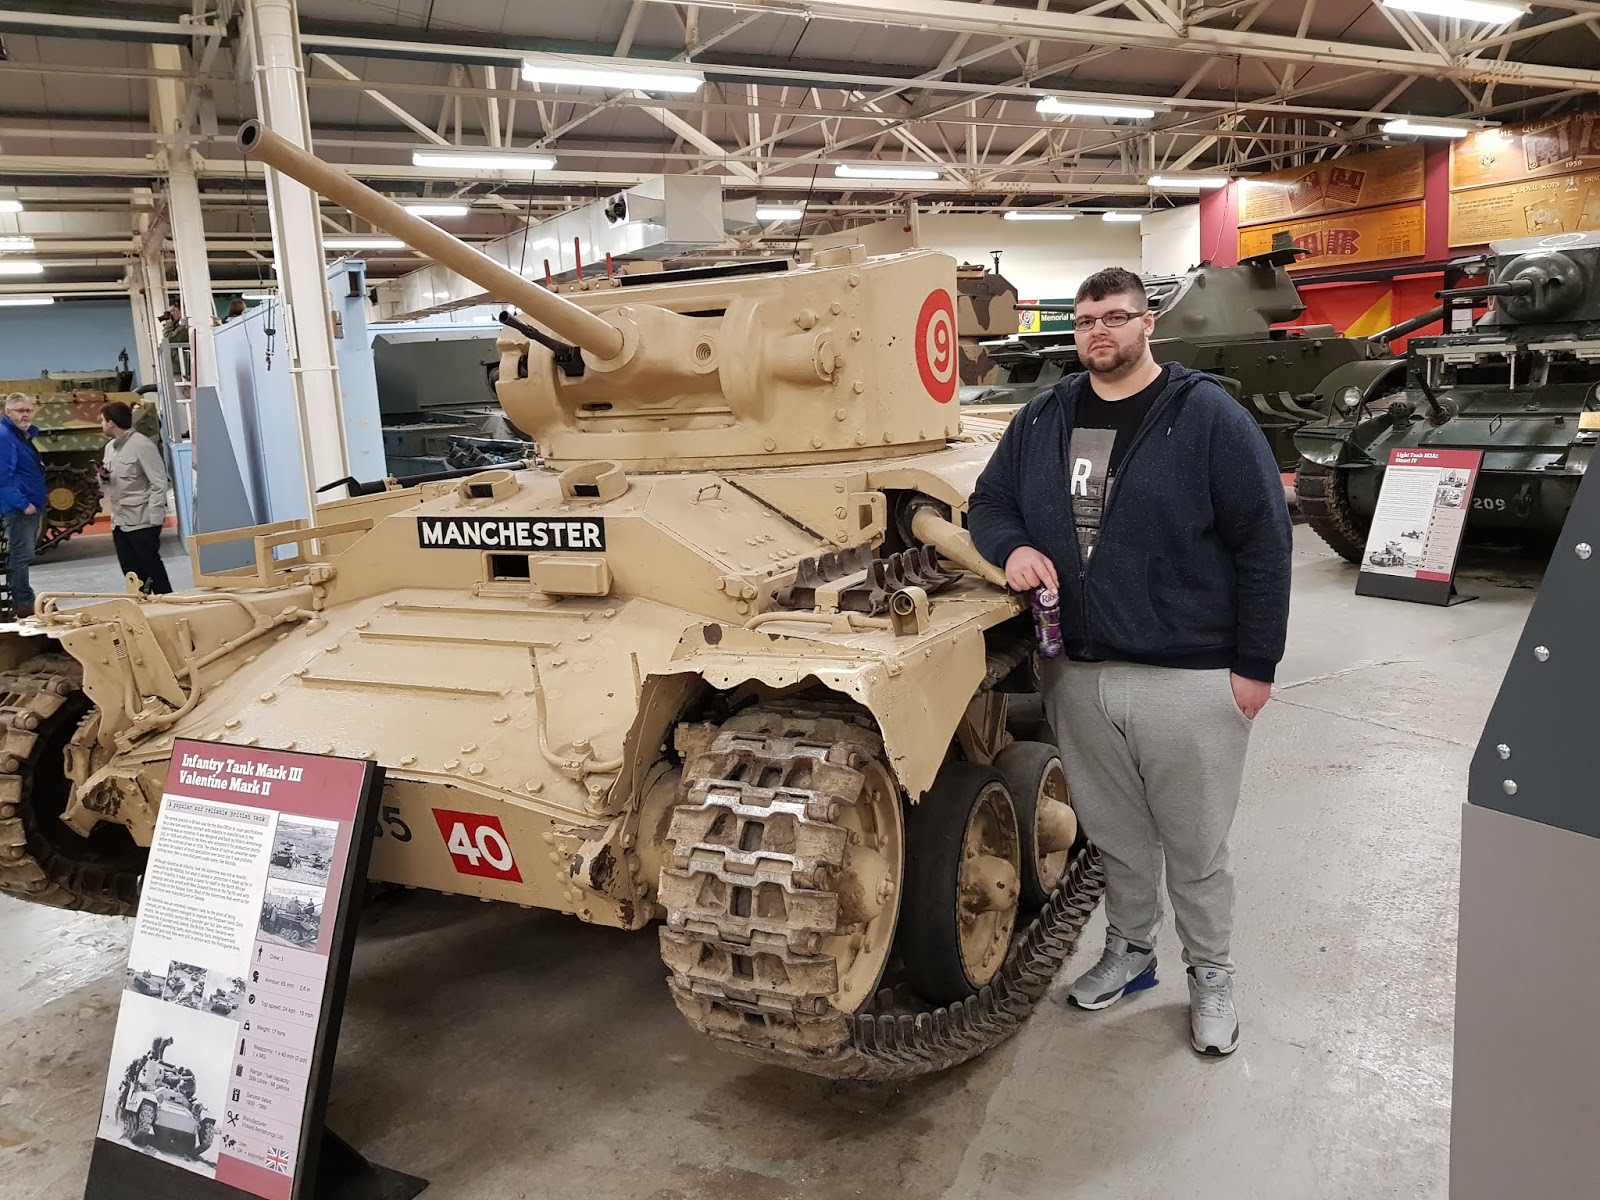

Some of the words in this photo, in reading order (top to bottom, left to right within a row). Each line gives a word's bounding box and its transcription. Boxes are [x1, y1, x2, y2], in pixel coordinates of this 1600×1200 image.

[1041, 313, 1068, 321] Memorial
[934, 320, 949, 373] 9
[1070, 457, 1093, 496] R
[1474, 498, 1506, 511] 209
[421, 521, 602, 548] MANCHESTER
[182, 753, 225, 775] Infantry
[226, 759, 255, 776] Tank
[256, 762, 288, 780] Mark
[288, 767, 303, 782] III
[180, 769, 227, 789] Valentine
[229, 777, 260, 794] Mark
[261, 781, 271, 795] II
[173, 802, 192, 810] popular
[204, 806, 227, 815] reliable
[447, 822, 513, 871] 40
